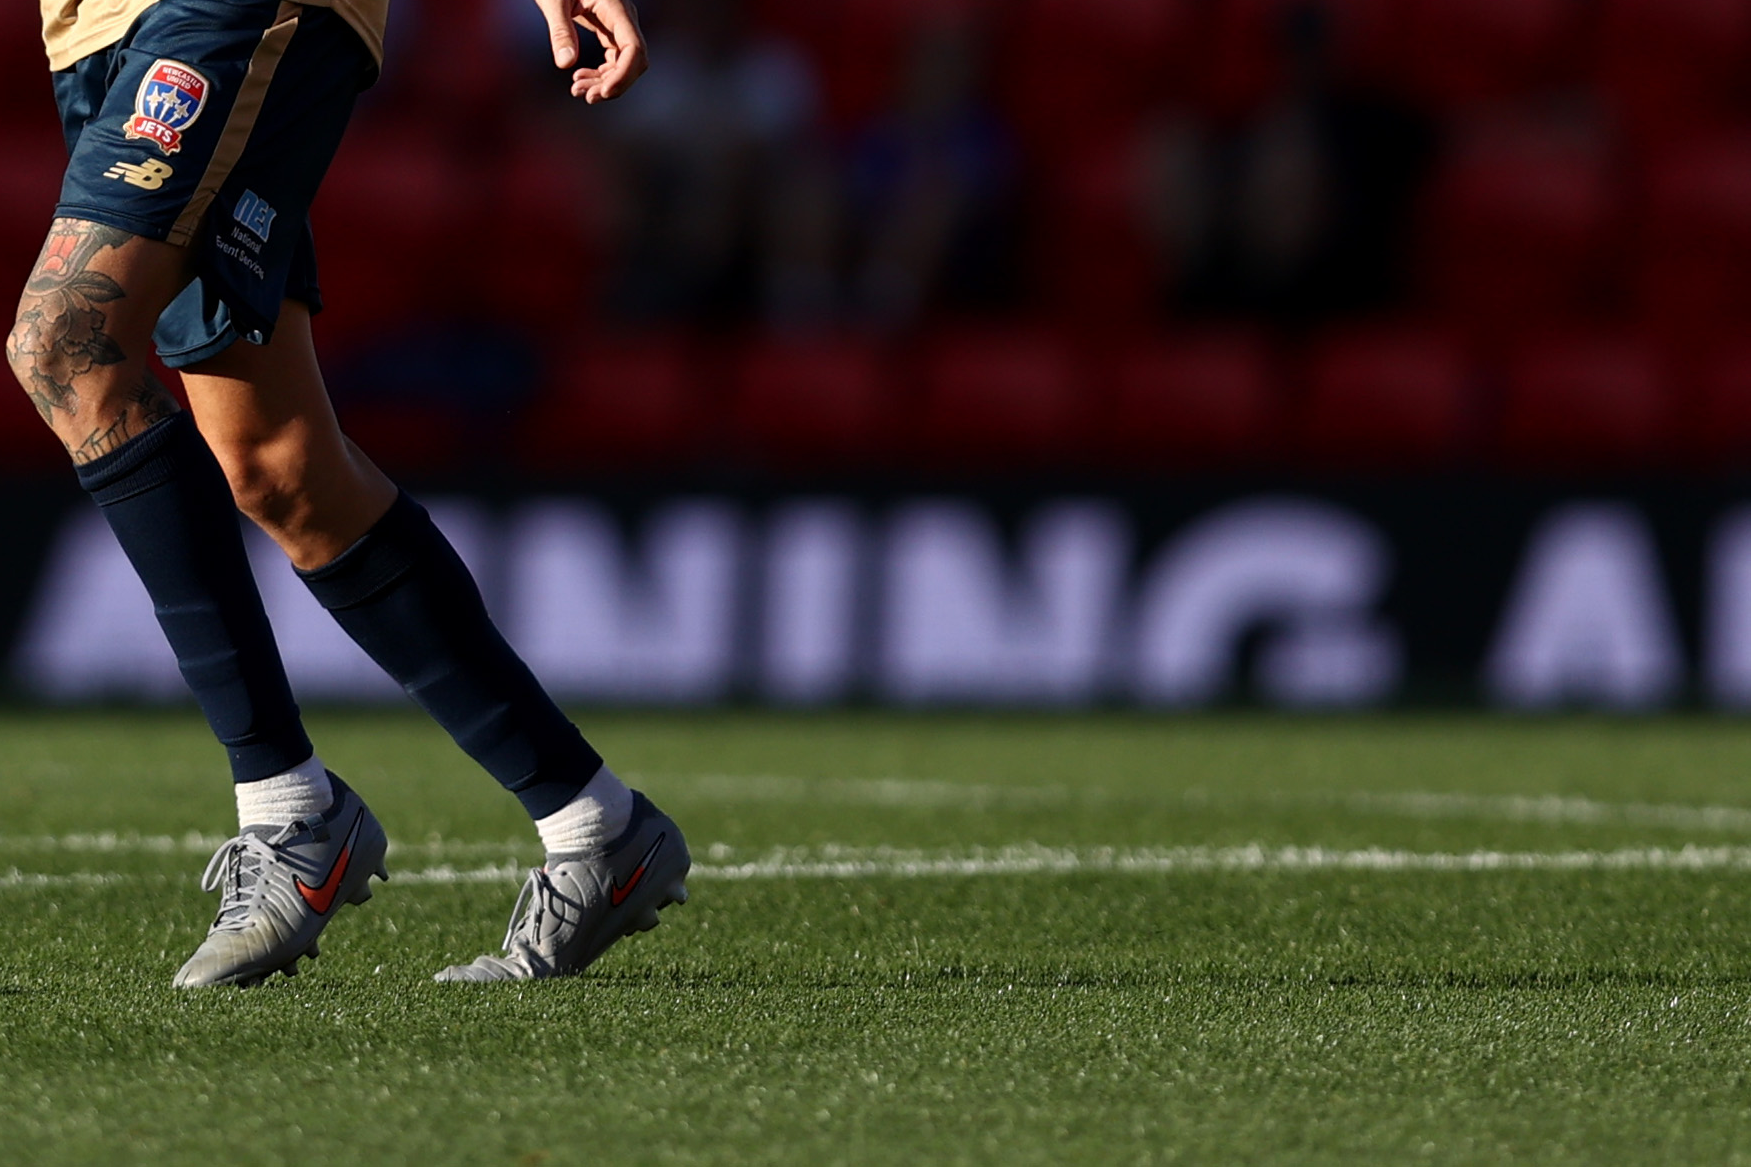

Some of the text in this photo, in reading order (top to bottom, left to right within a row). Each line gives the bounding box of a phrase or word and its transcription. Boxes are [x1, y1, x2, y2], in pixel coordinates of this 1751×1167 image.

[162, 66, 202, 89] NEWCASTLE
[166, 74, 191, 89] UNITED
[136, 120, 173, 143] JETS
[216, 234, 240, 258] Event
[231, 226, 262, 254] National
